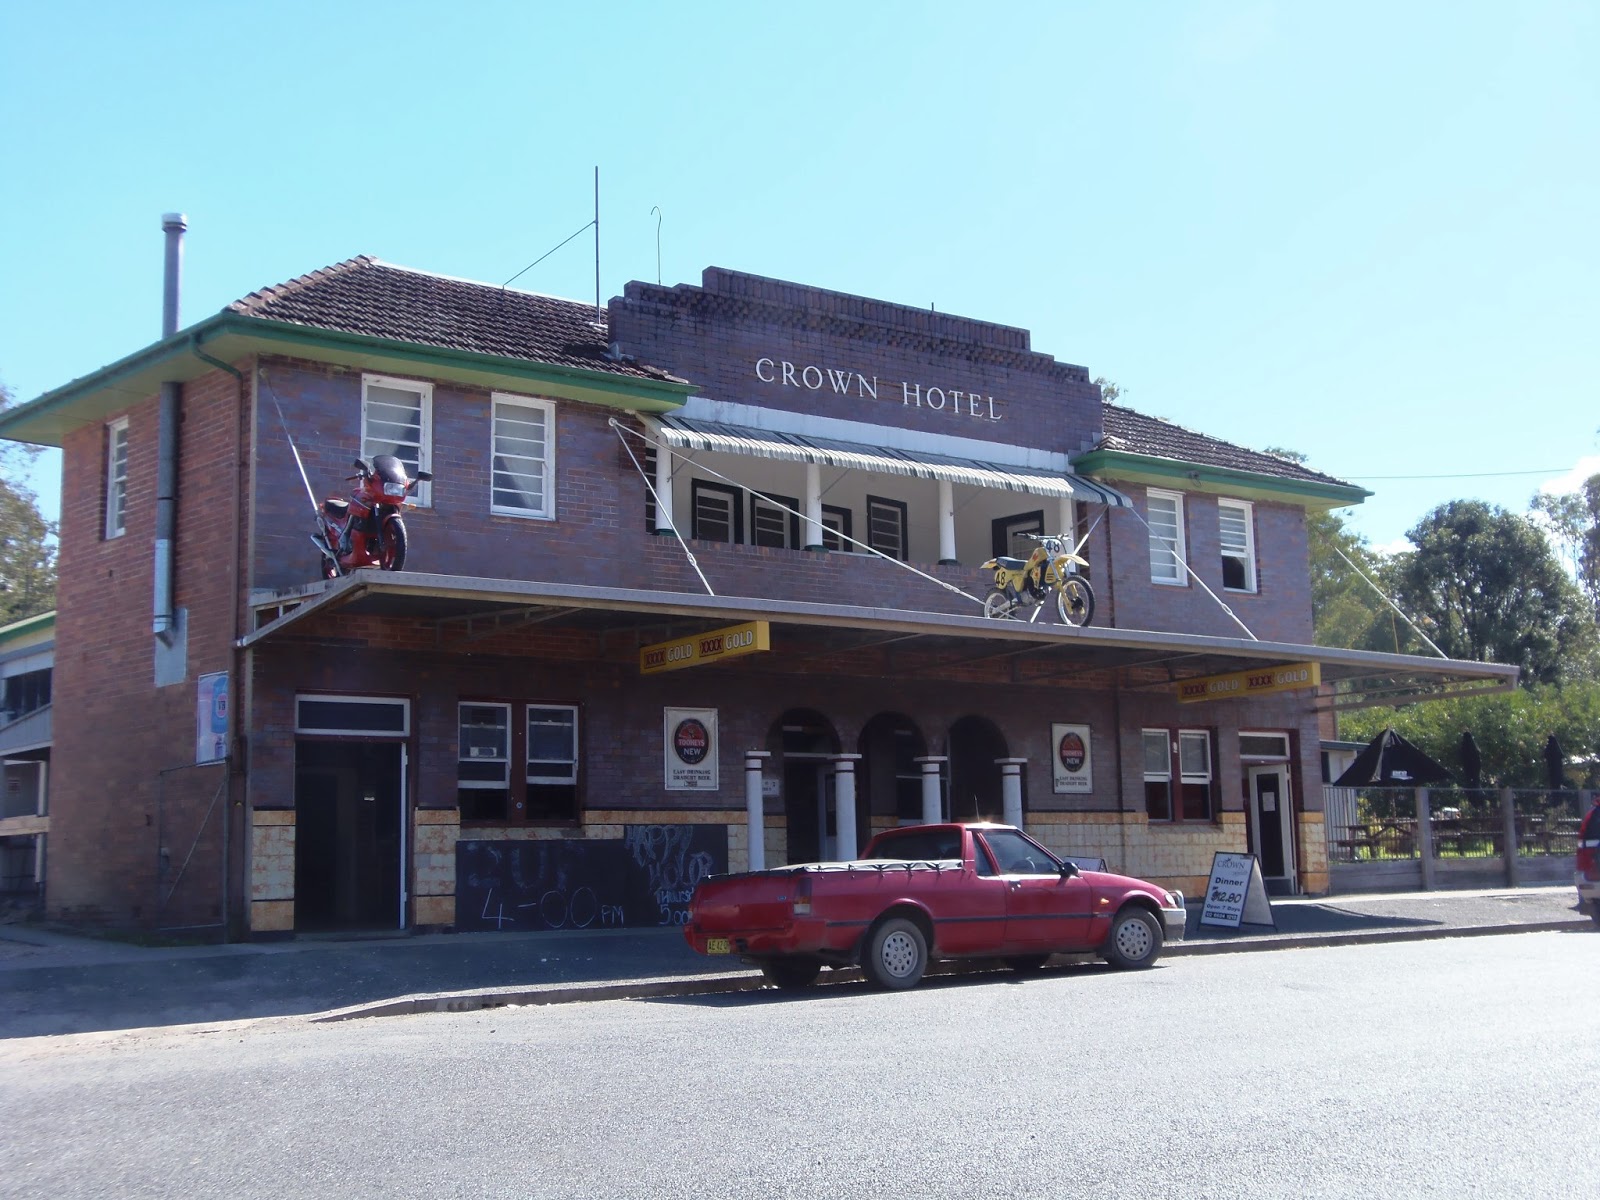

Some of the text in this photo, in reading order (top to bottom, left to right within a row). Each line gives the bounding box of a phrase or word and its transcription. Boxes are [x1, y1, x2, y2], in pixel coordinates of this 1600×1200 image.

[755, 358, 1003, 420] CROWN HOTEL
[1045, 540, 1060, 553] 48
[995, 571, 1006, 586] 48
[667, 644, 692, 662] GOLD
[700, 637, 723, 654] XXXX
[725, 630, 753, 650] GOLD
[1209, 679, 1240, 693] GOLD
[1248, 673, 1273, 688] XXXX
[1276, 669, 1308, 684] GOLD
[678, 738, 705, 747] TOOHEYS
[683, 747, 702, 756] NEW
[1066, 757, 1080, 765] NEW
[1217, 860, 1246, 869] CROWN
[1215, 877, 1244, 887] Dinner
[601, 904, 625, 925] PM
